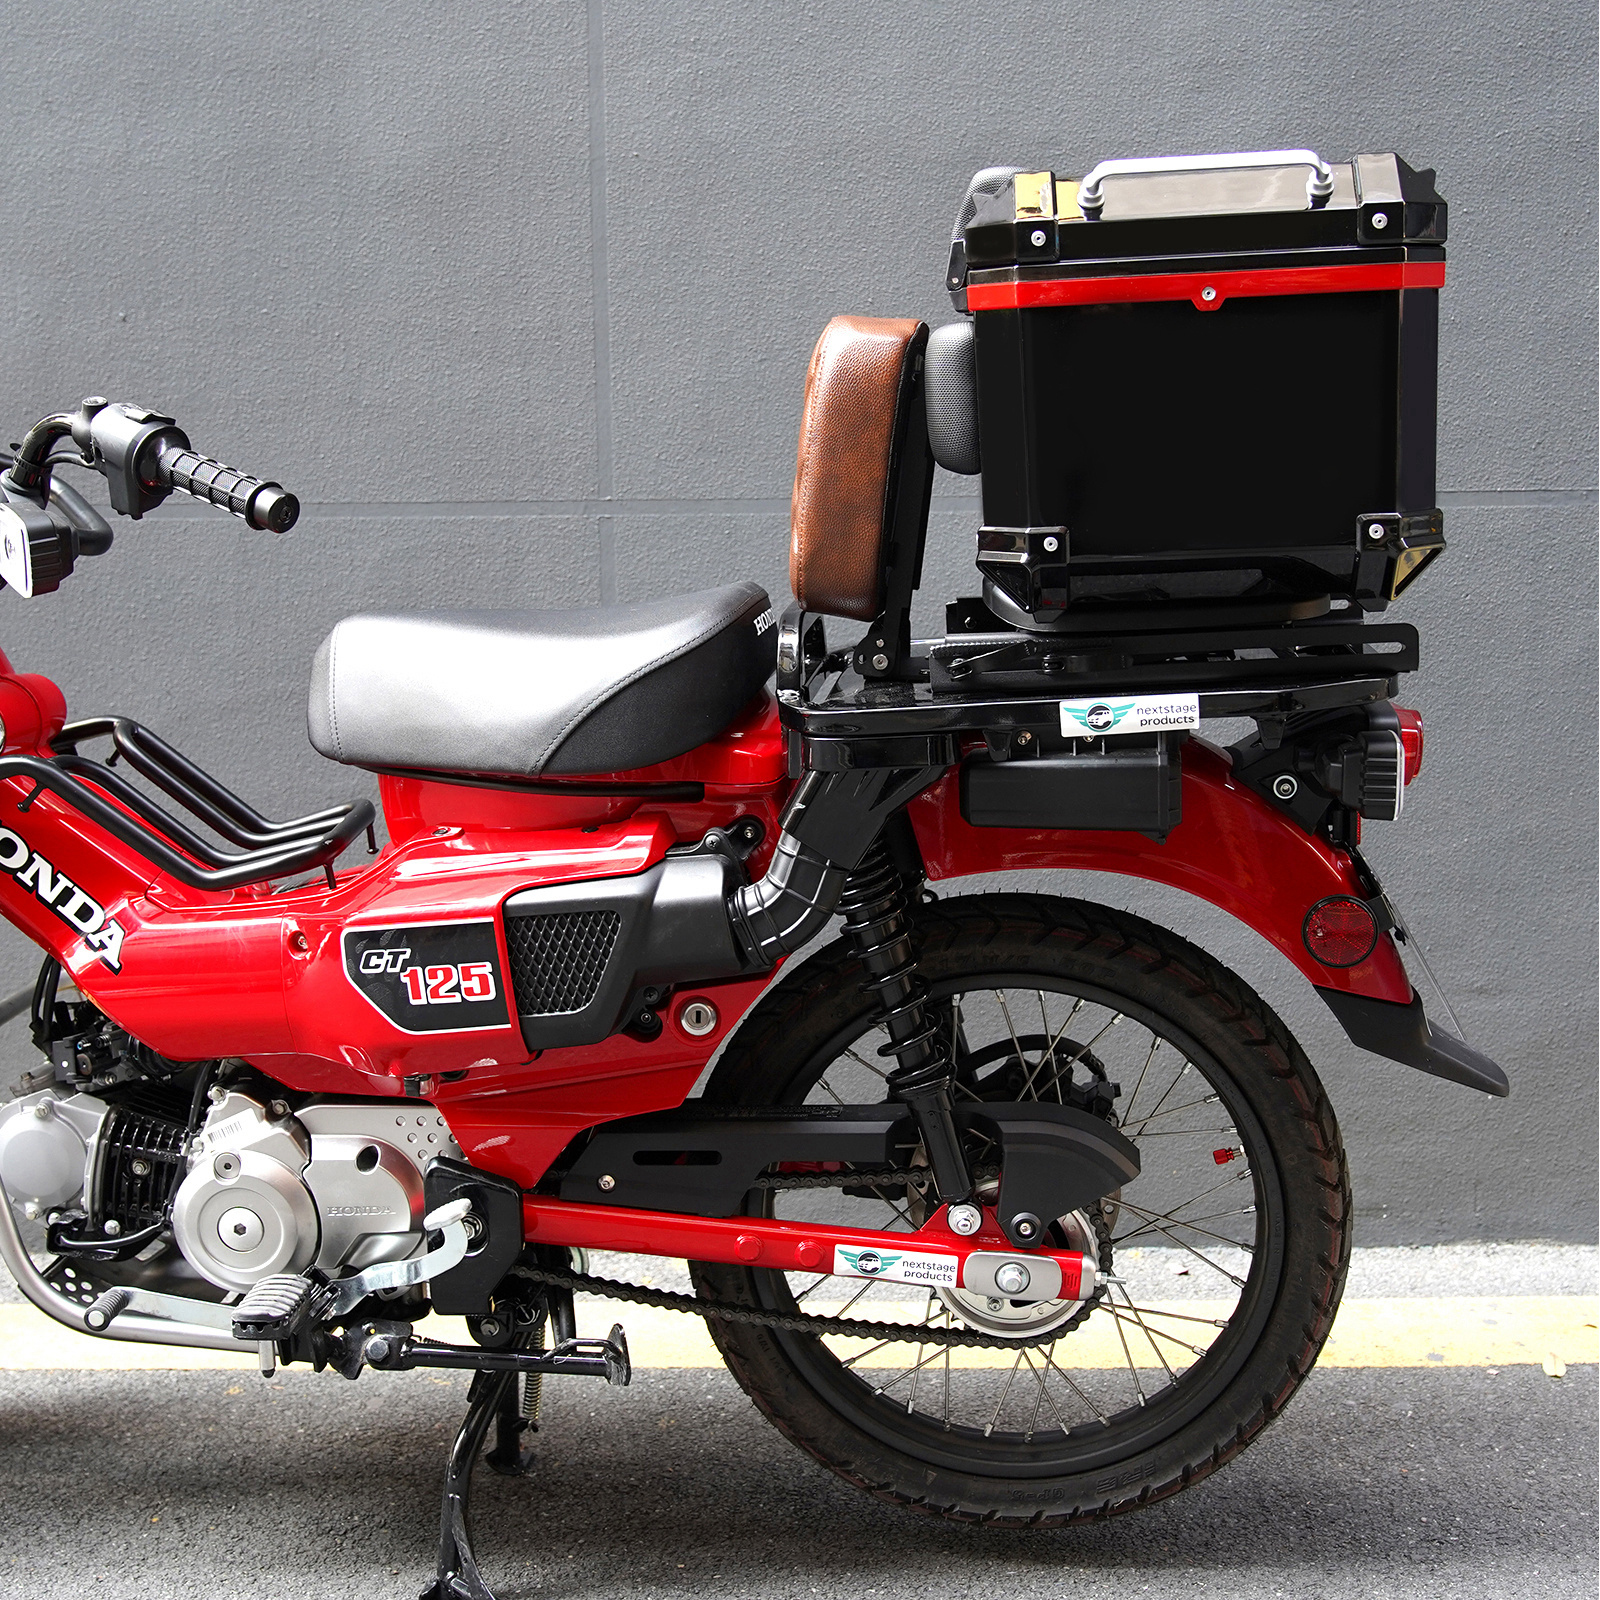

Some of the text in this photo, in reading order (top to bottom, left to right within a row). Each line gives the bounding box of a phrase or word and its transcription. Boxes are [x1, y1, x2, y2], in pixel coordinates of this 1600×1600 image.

[753, 607, 776, 636] HON
[1136, 703, 1197, 715] nextstage
[1140, 715, 1195, 727] products
[0, 826, 125, 973] ONDA
[359, 948, 411, 974] CT
[400, 961, 496, 1005] 125
[326, 1205, 397, 1217] HONDA
[902, 1260, 956, 1273] nextstage
[904, 1270, 953, 1282] products
